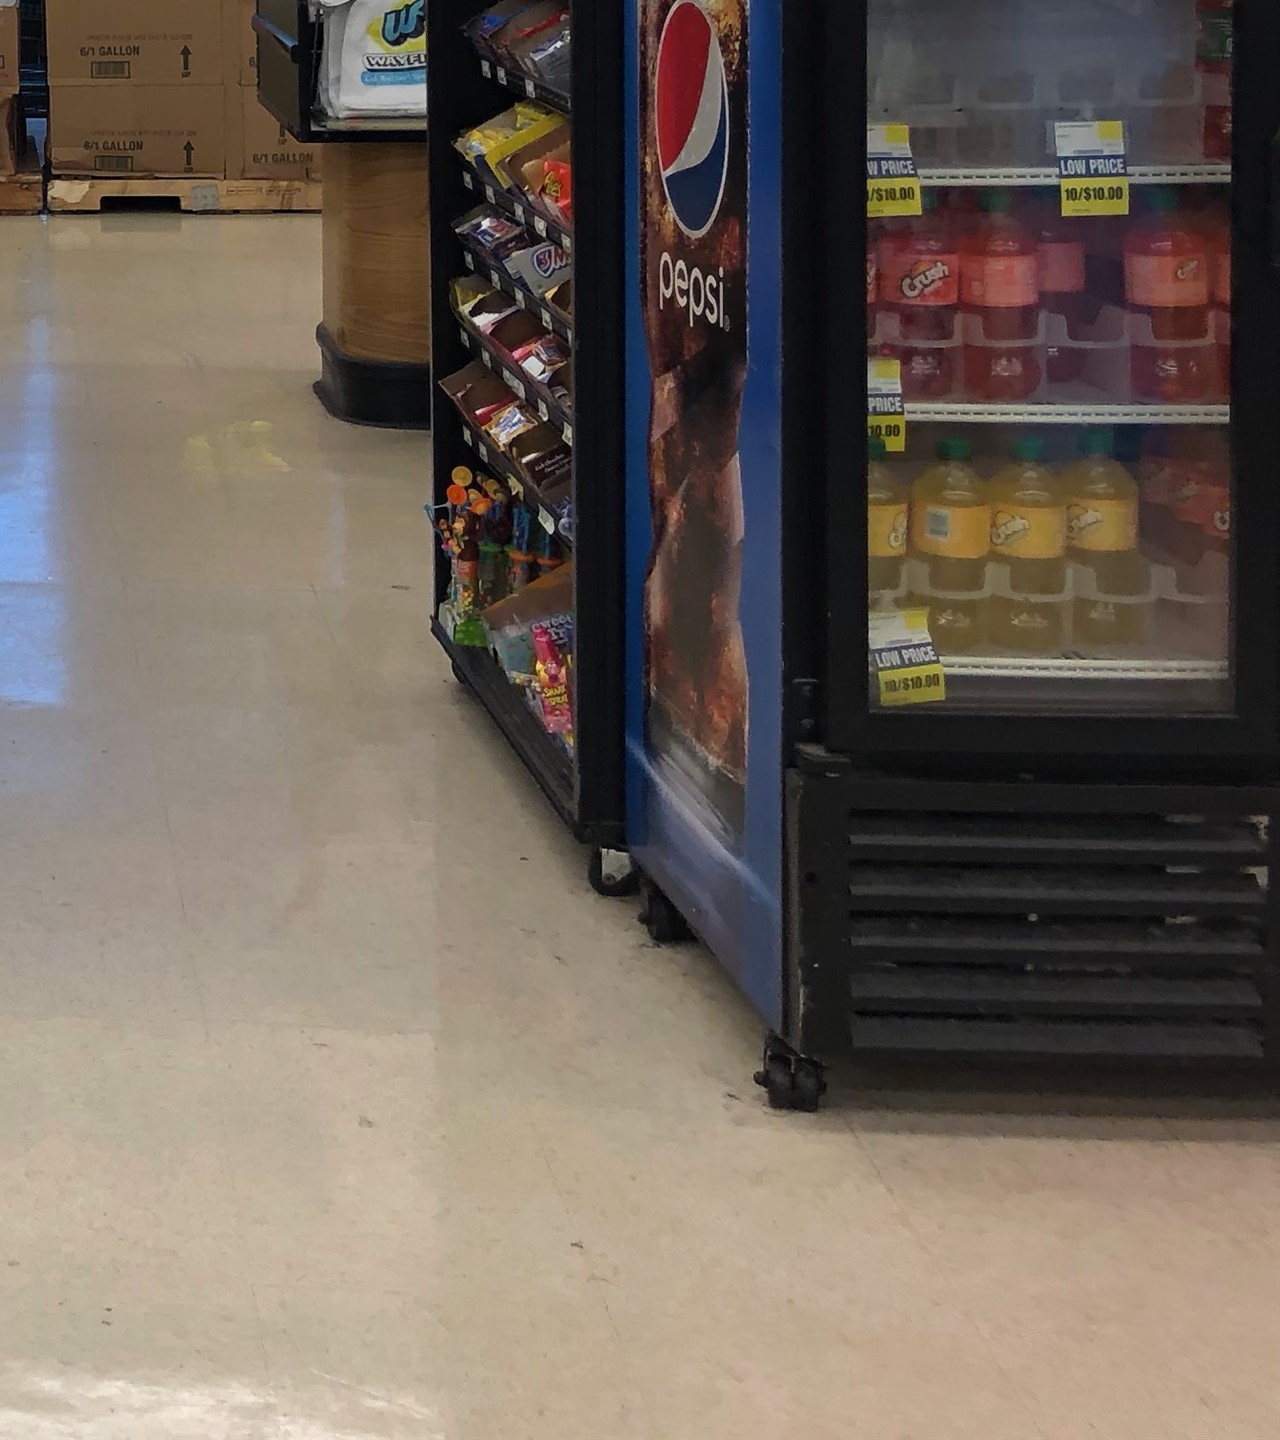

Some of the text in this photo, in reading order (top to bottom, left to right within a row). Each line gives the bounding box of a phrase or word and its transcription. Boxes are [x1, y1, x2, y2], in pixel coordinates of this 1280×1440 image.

[80, 46, 140, 57] 6/1 GALLON
[366, 53, 428, 68] WAYFI
[83, 140, 143, 152] 6/1 GALLON
[271, 152, 313, 163] GALLON
[879, 159, 915, 176] PRICE
[1060, 158, 1125, 176] LOW PRICE
[1064, 185, 1123, 202] 10/$10.00
[901, 260, 951, 298] Crush
[659, 251, 724, 328] pepsi
[868, 396, 903, 413] PRICE
[874, 645, 938, 668] LOW PRICE
